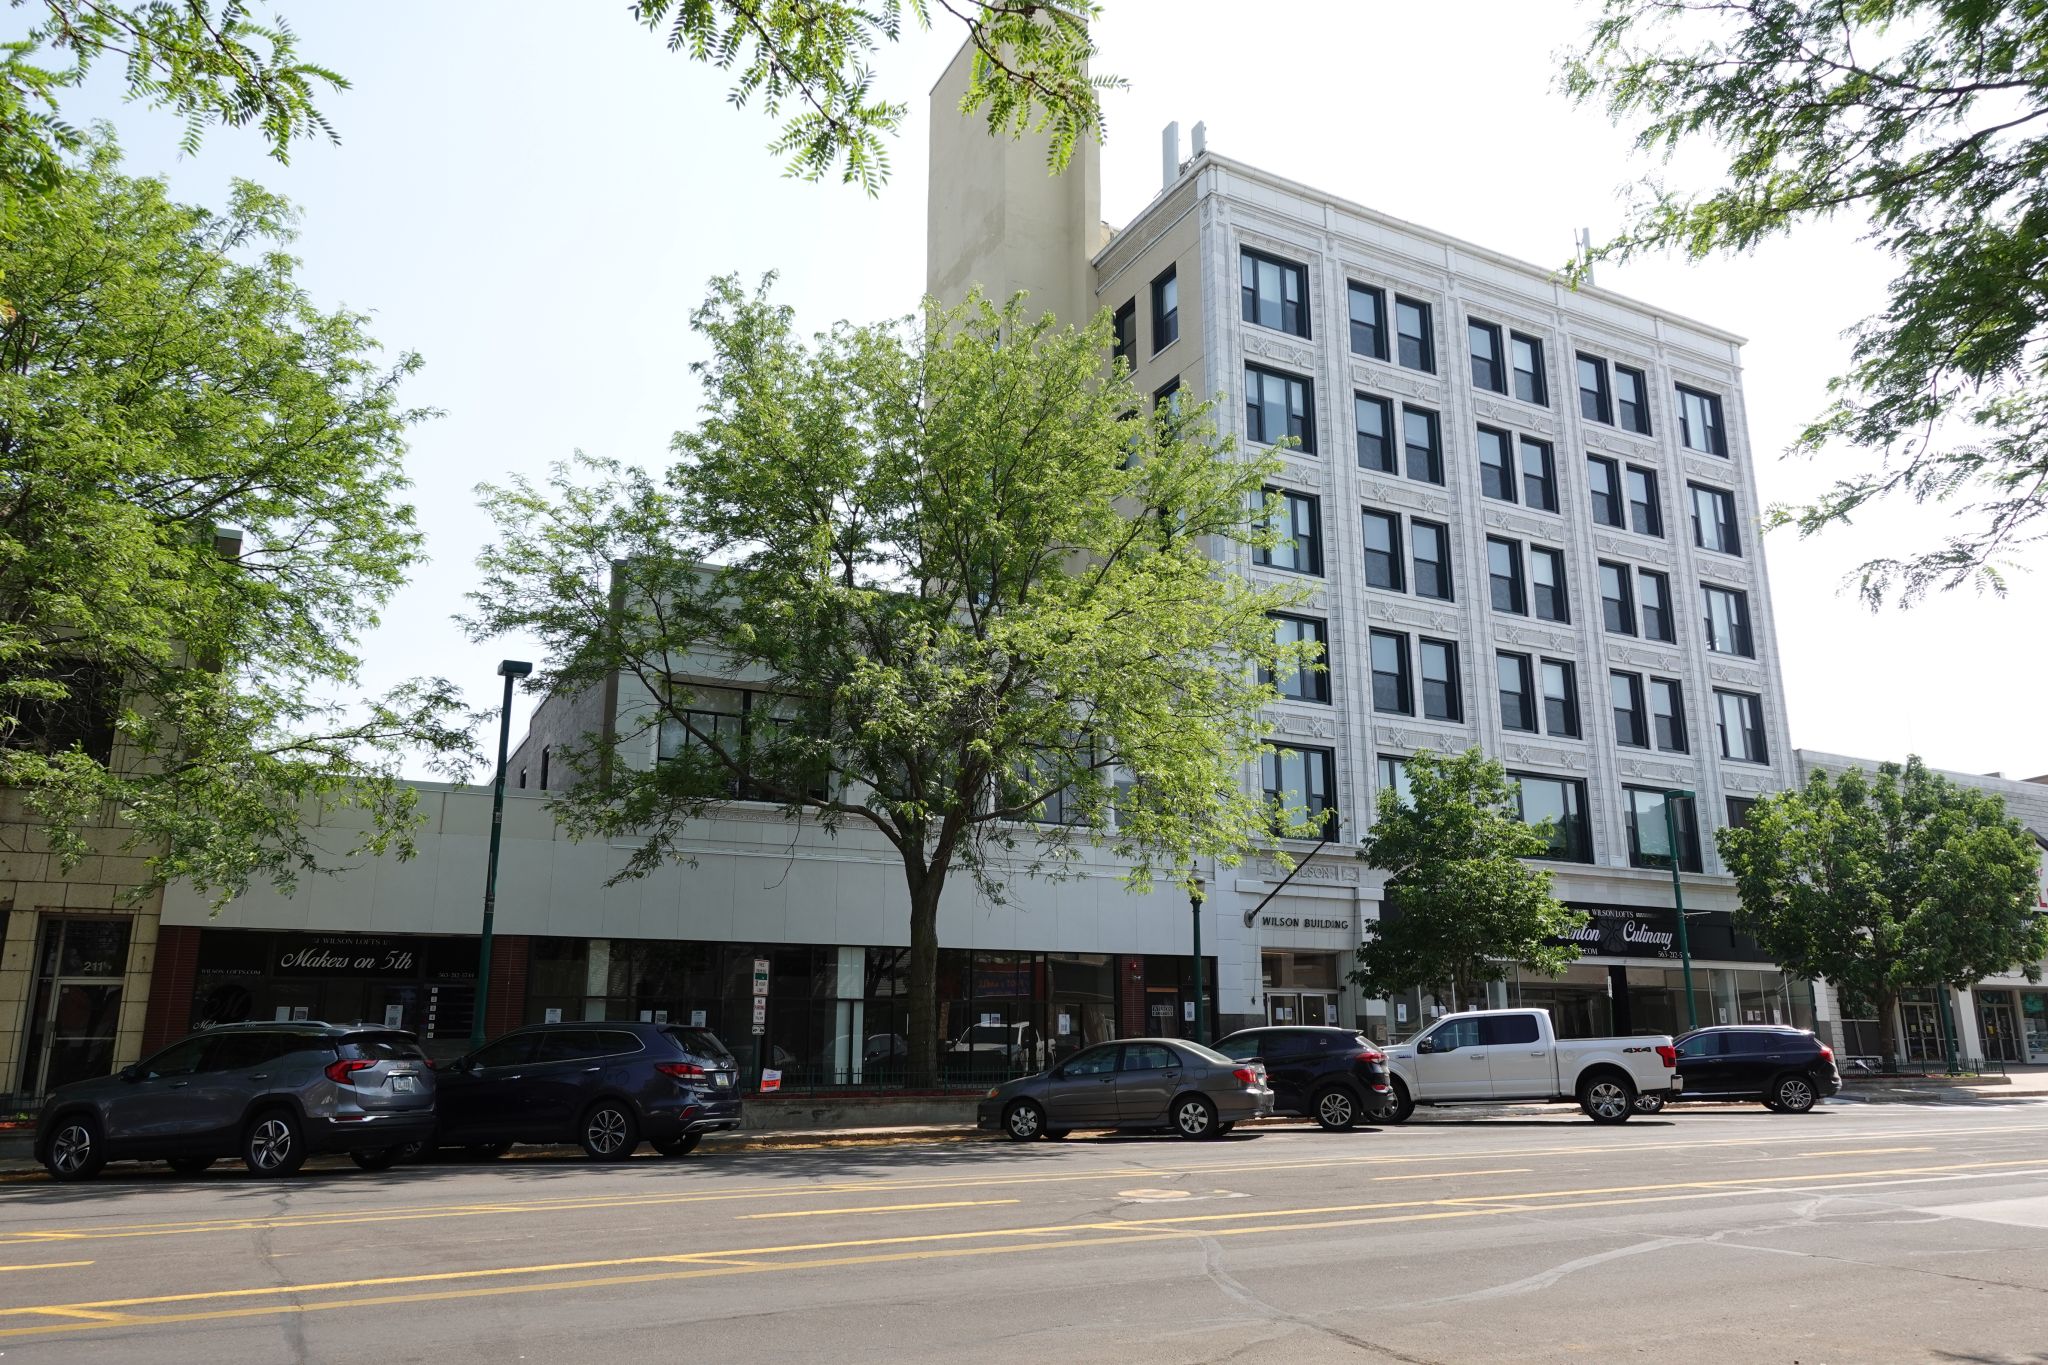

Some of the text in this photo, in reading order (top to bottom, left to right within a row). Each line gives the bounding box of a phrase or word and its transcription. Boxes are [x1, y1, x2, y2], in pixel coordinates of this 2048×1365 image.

[1592, 908, 1634, 919] WILSON LOFTS
[1262, 916, 1349, 929] WILSON BUILDING
[323, 937, 381, 945] WILSON LOFTS
[1622, 919, 1673, 951] Culinary
[280, 947, 413, 970] Makers on 5th
